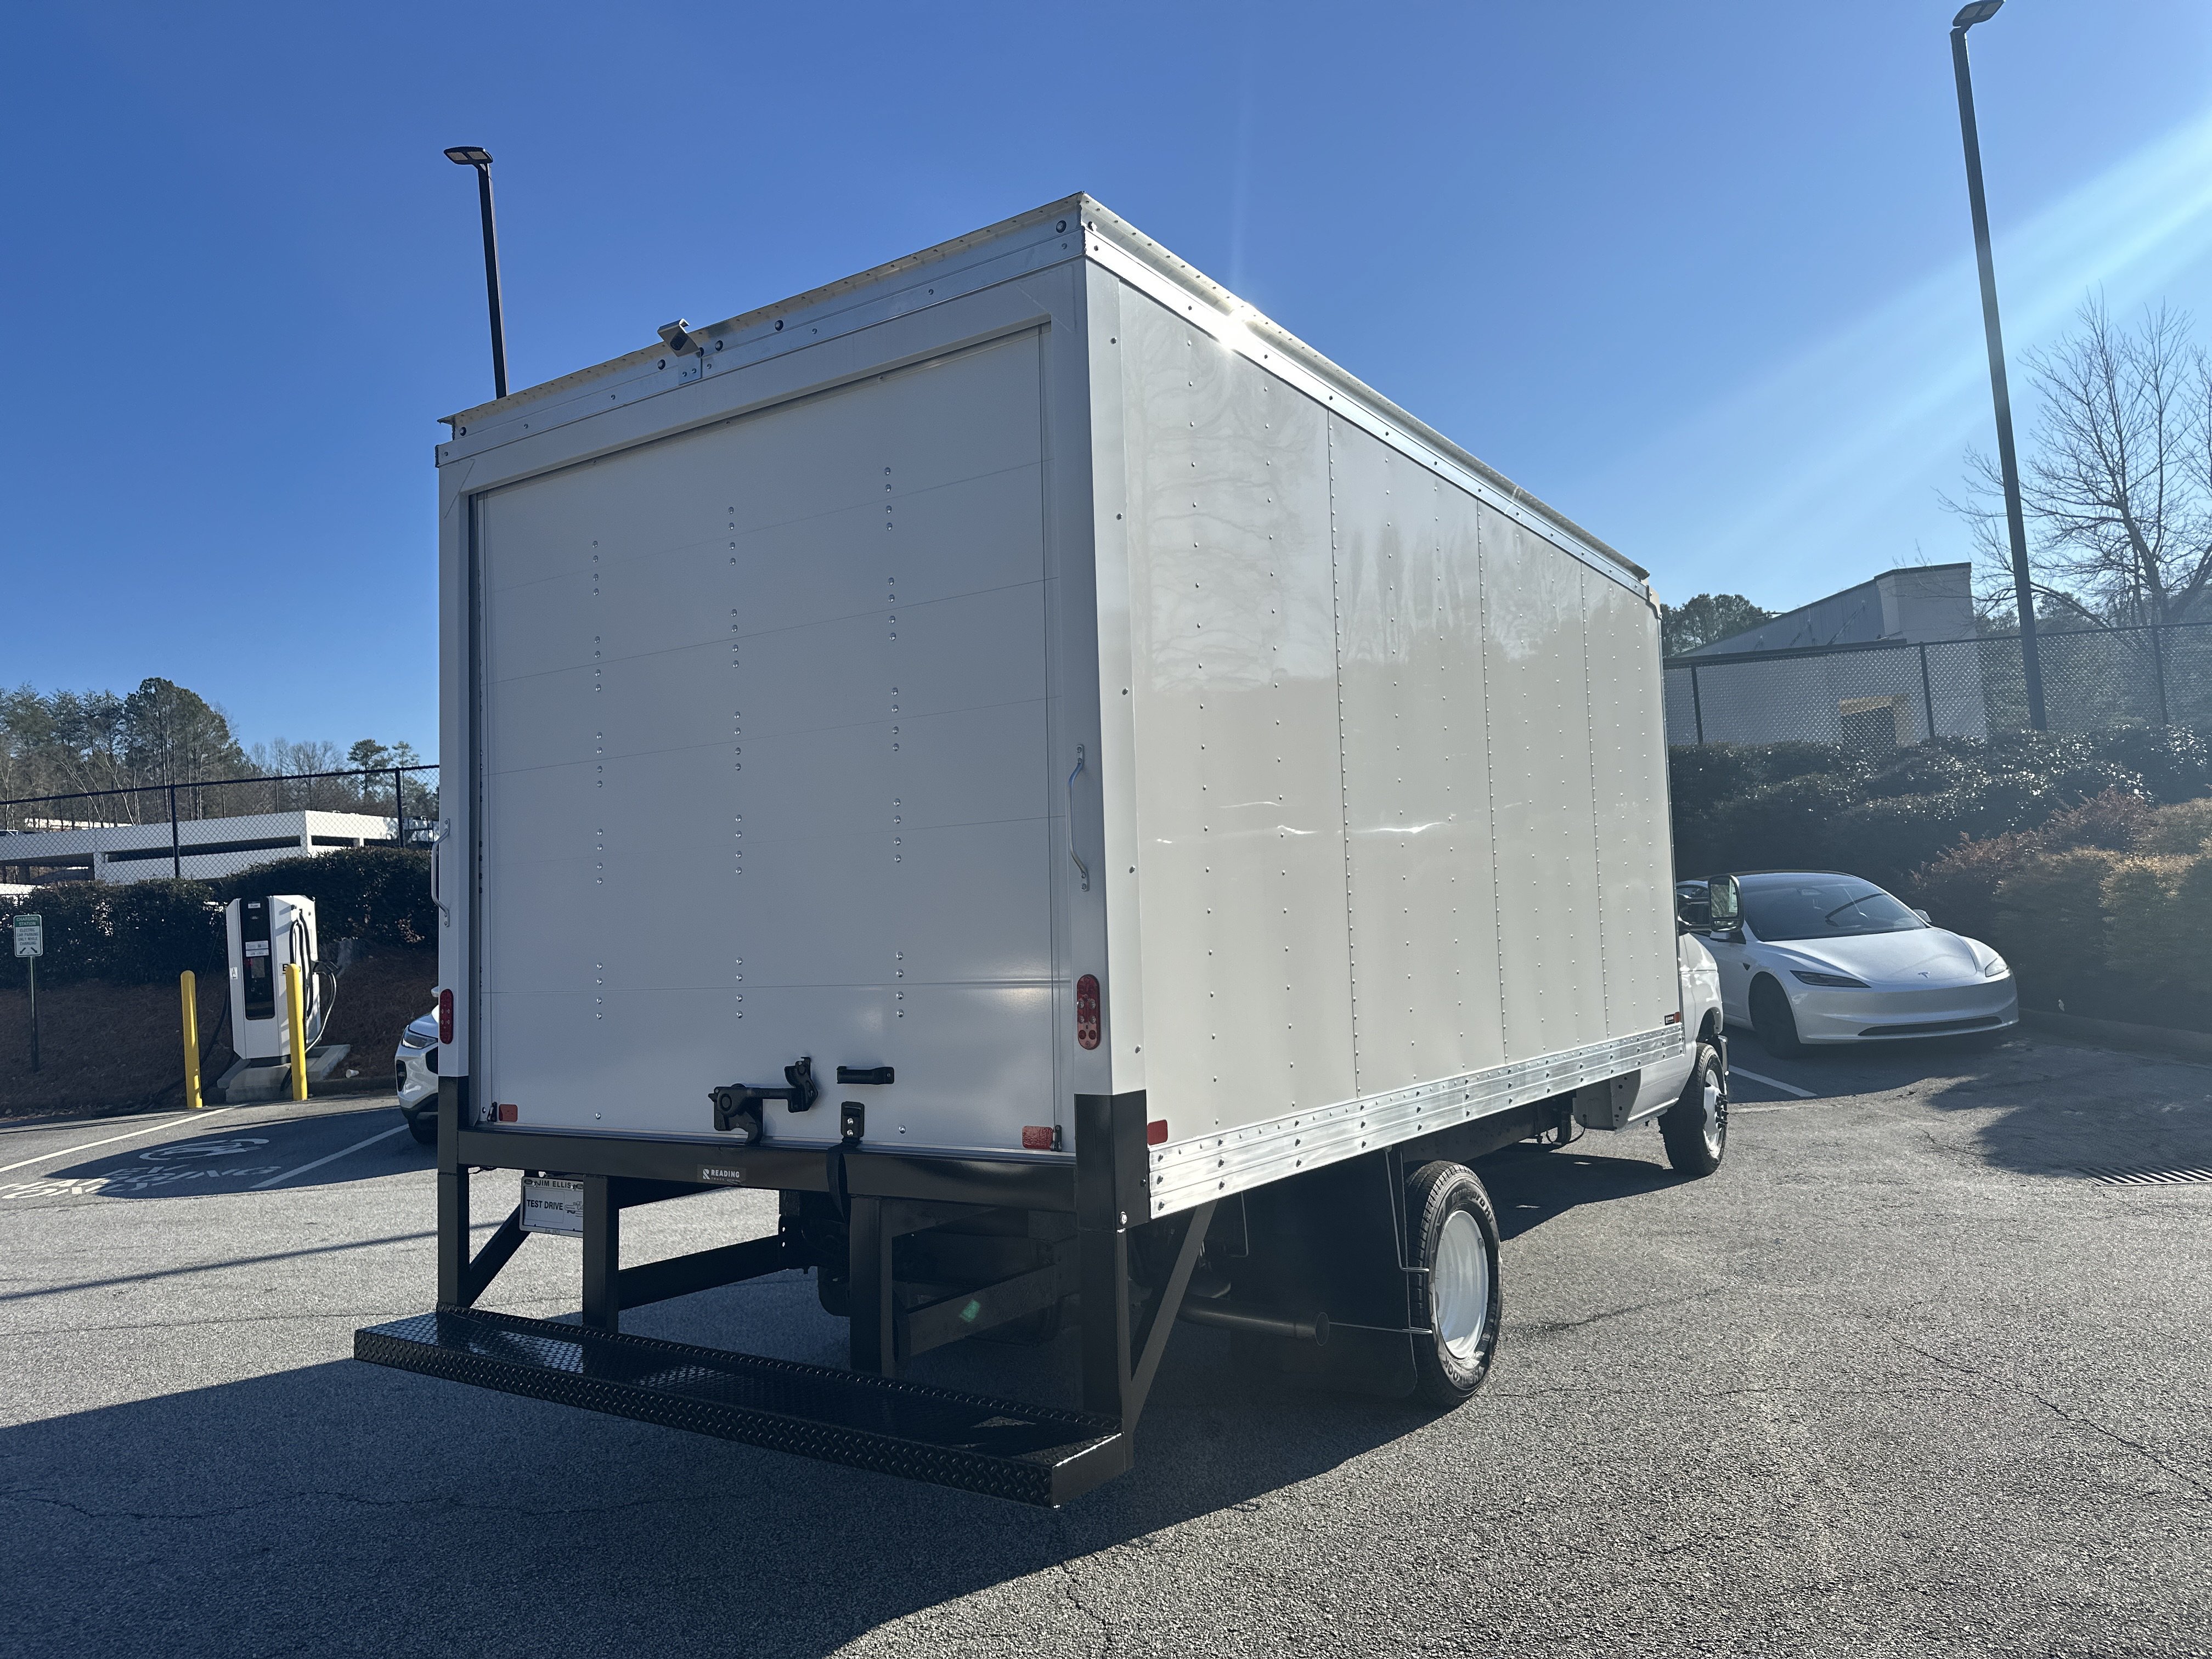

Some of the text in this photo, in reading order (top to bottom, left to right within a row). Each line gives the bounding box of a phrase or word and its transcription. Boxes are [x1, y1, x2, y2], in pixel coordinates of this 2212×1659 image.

[0, 1166, 282, 1190] HARGING
[711, 1169, 740, 1178] READING
[527, 1199, 563, 1210] TEST DRIVE
